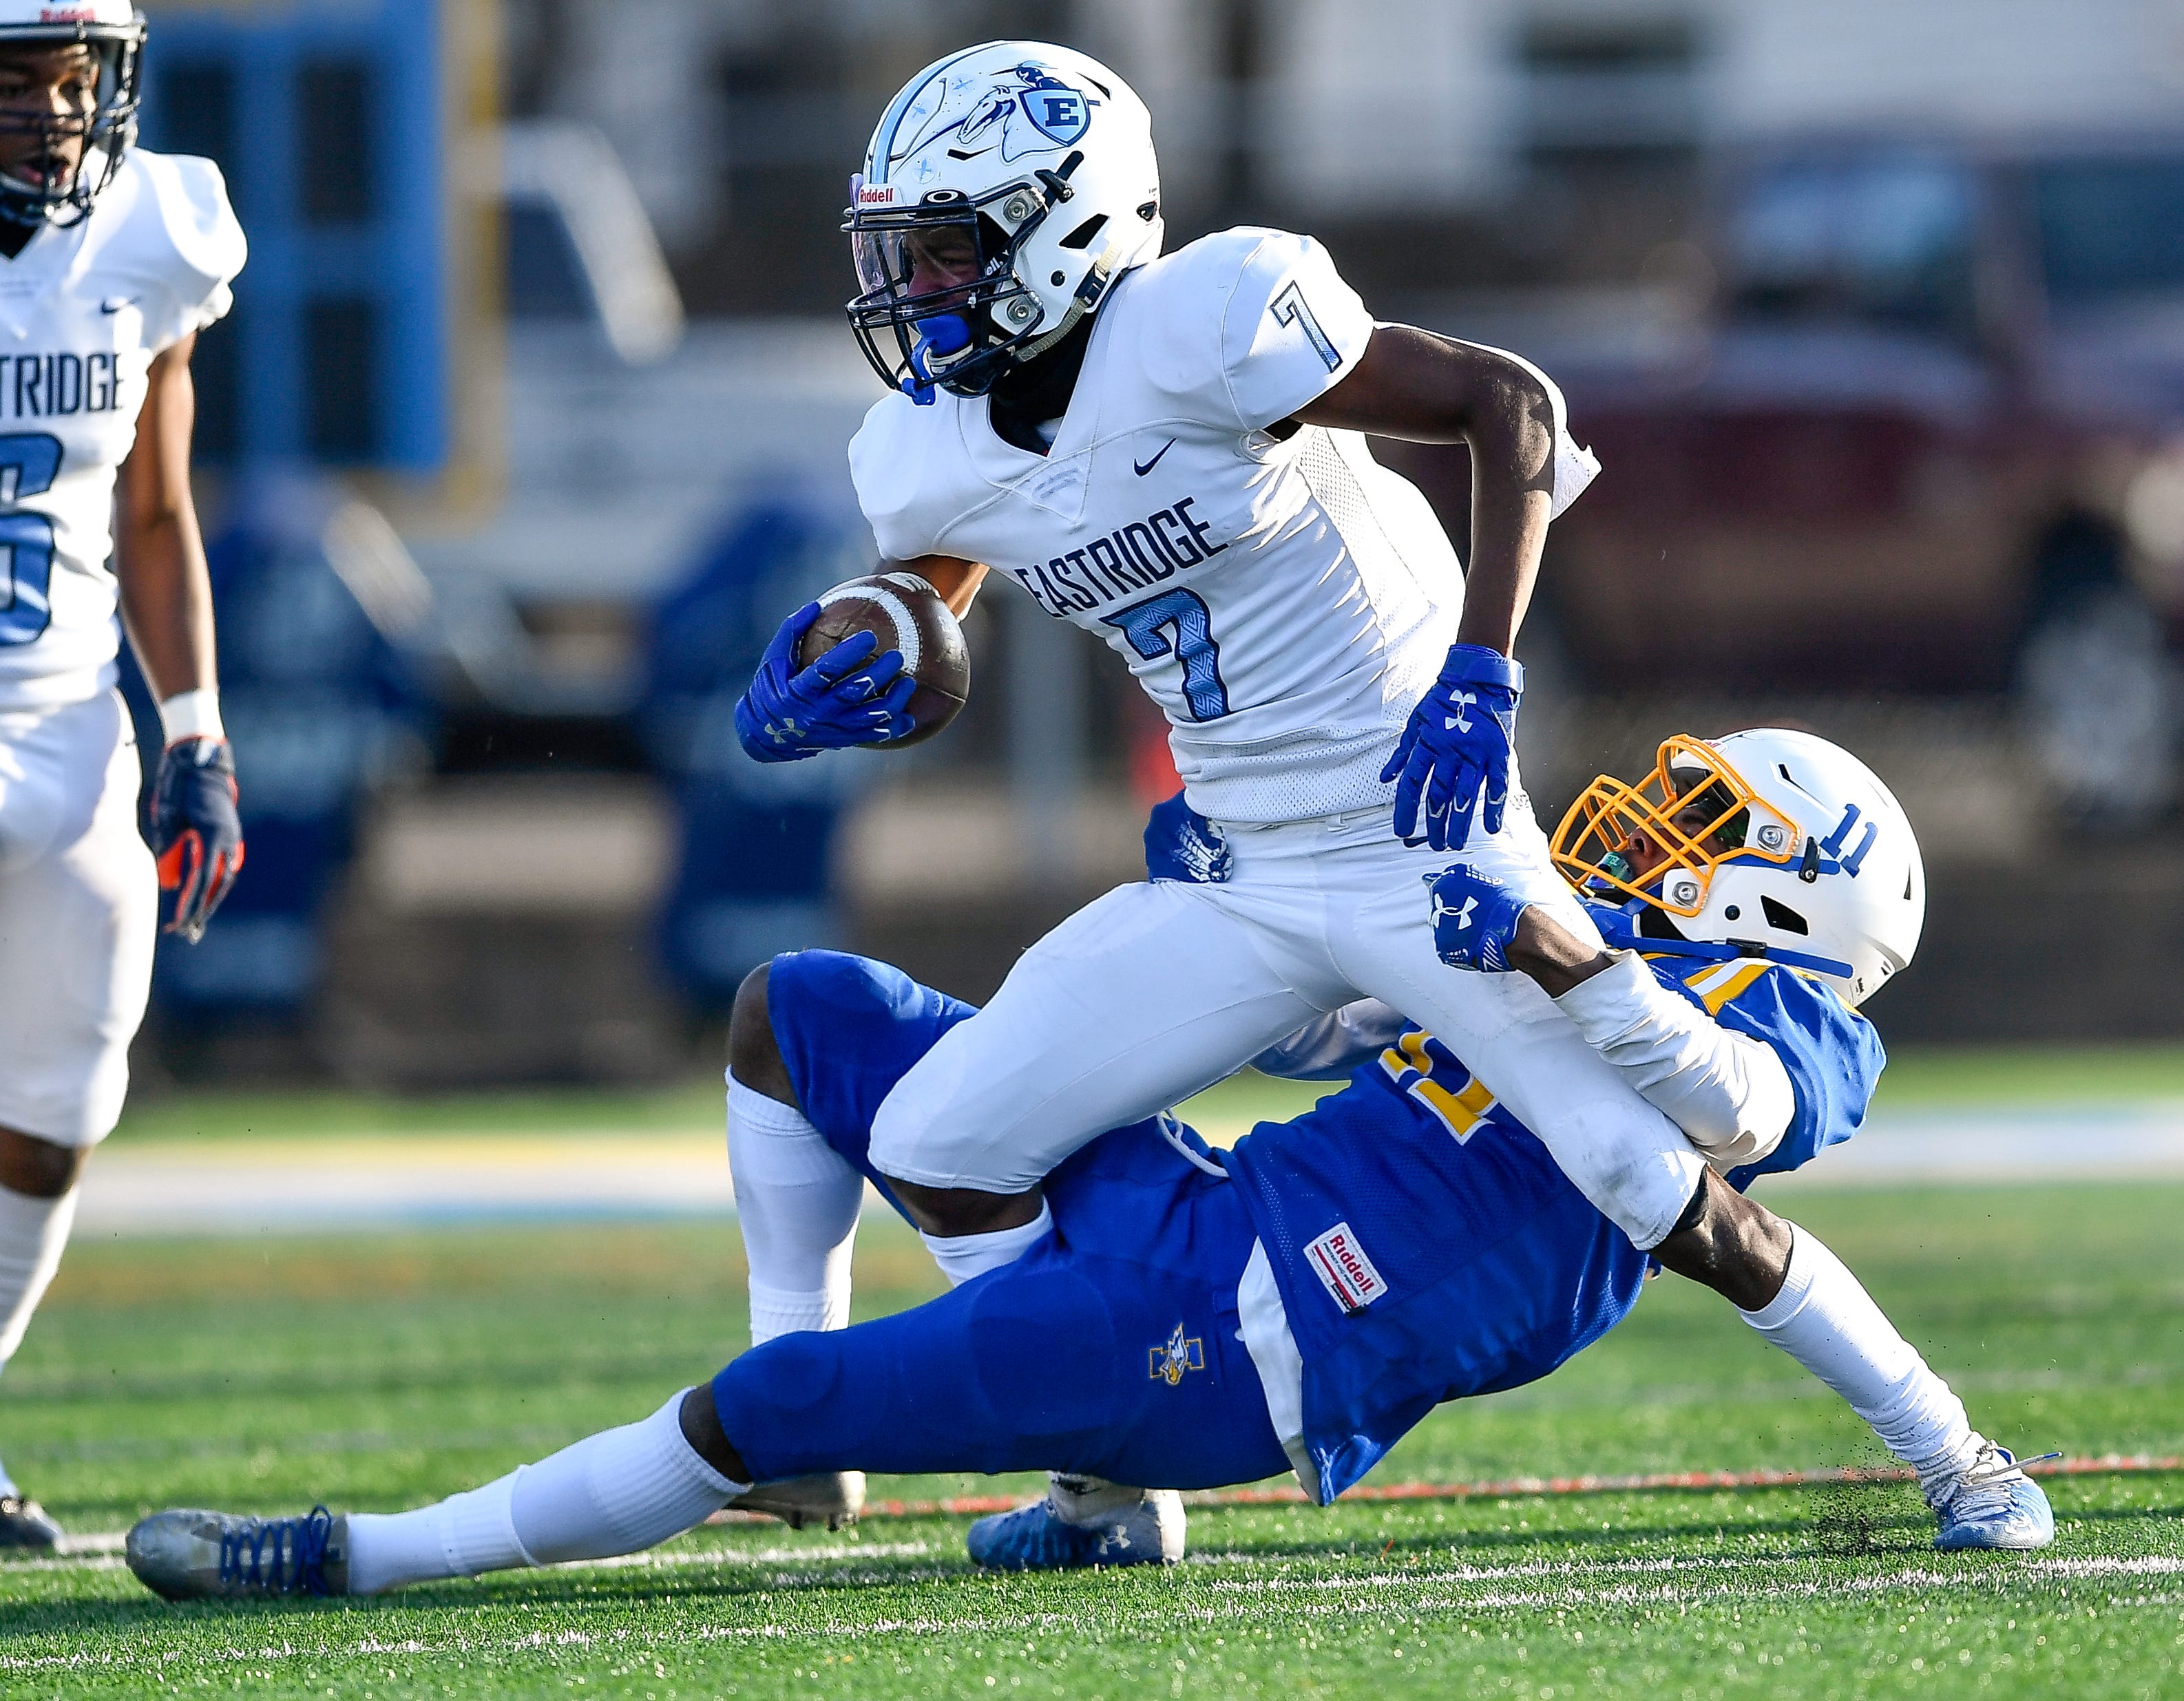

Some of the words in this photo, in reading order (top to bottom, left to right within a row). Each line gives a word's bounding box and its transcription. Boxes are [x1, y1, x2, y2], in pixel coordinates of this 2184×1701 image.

[1043, 98, 1079, 127] E
[860, 188, 893, 202] Riddell
[1269, 280, 1343, 373] 7
[1014, 496, 1228, 617] EASTRIDGE
[1098, 587, 1230, 722] 7
[1818, 803, 1878, 878] 11
[1330, 1234, 1374, 1292] Riddell
